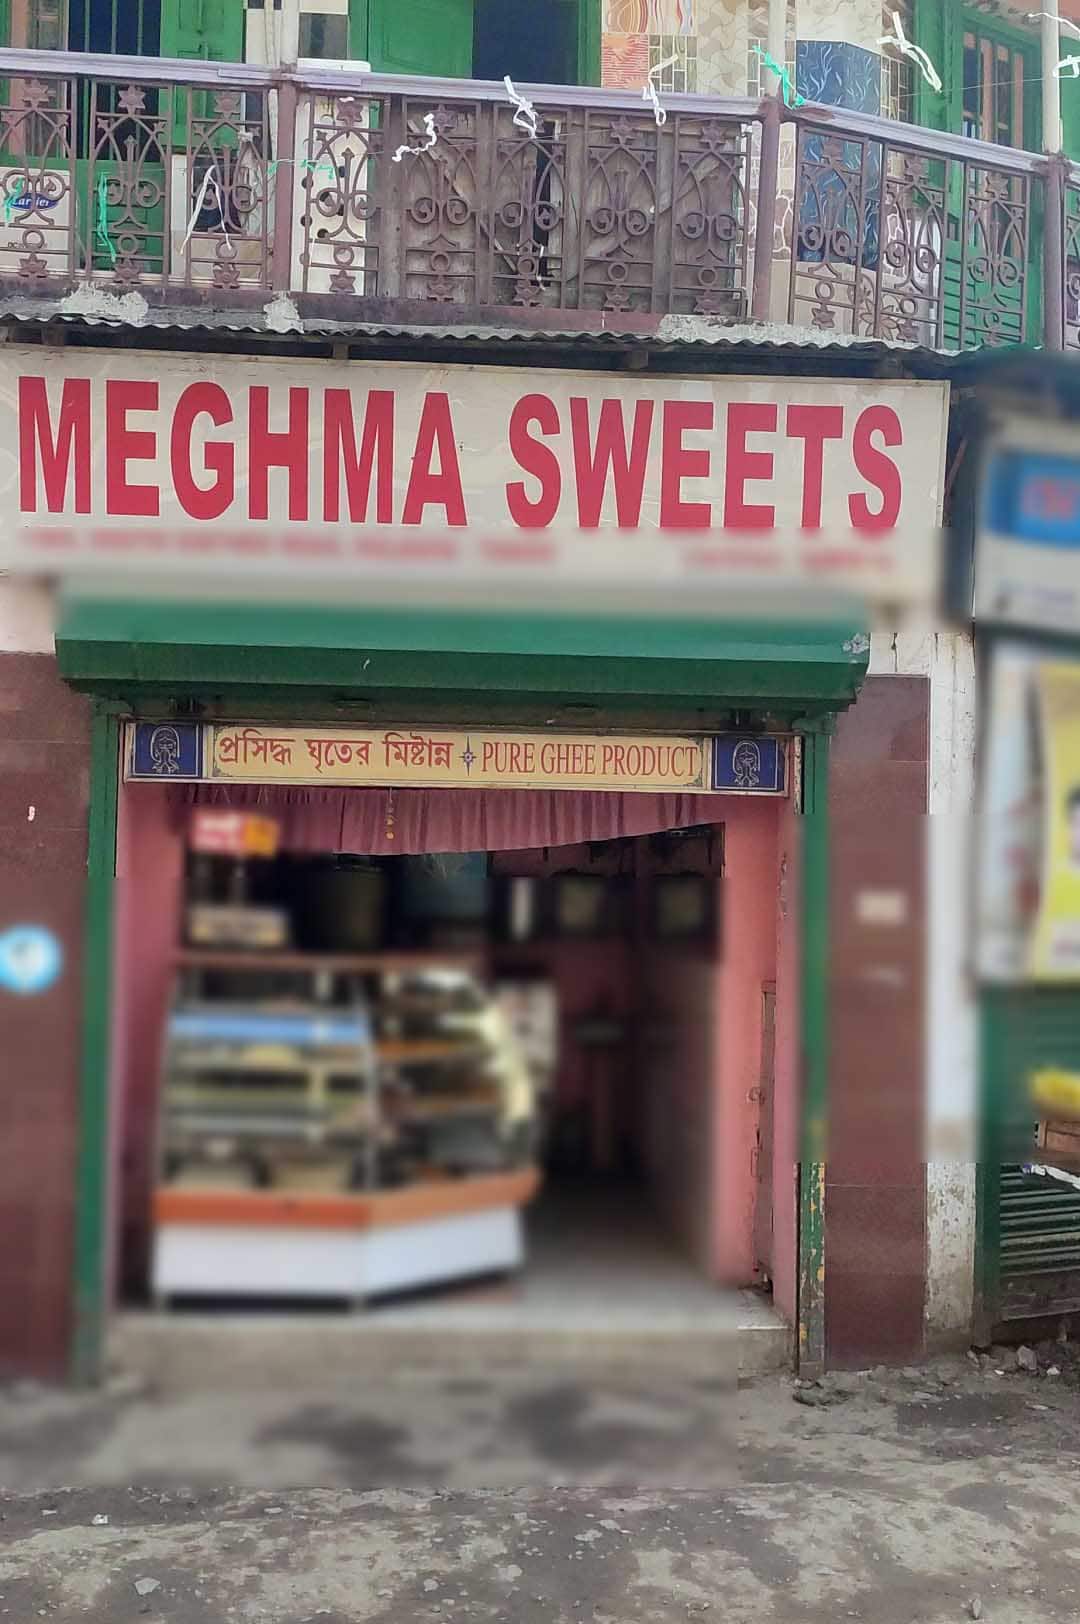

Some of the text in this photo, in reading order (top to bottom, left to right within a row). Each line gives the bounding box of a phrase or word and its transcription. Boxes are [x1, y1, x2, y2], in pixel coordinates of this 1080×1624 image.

[18, 376, 903, 538] MEGHMA SWEETS
[218, 728, 454, 773] প্রসিদ্ধ ঘৃতের মিষ্টান্ন
[481, 740, 698, 778] PURE GHEE PRODUCT
